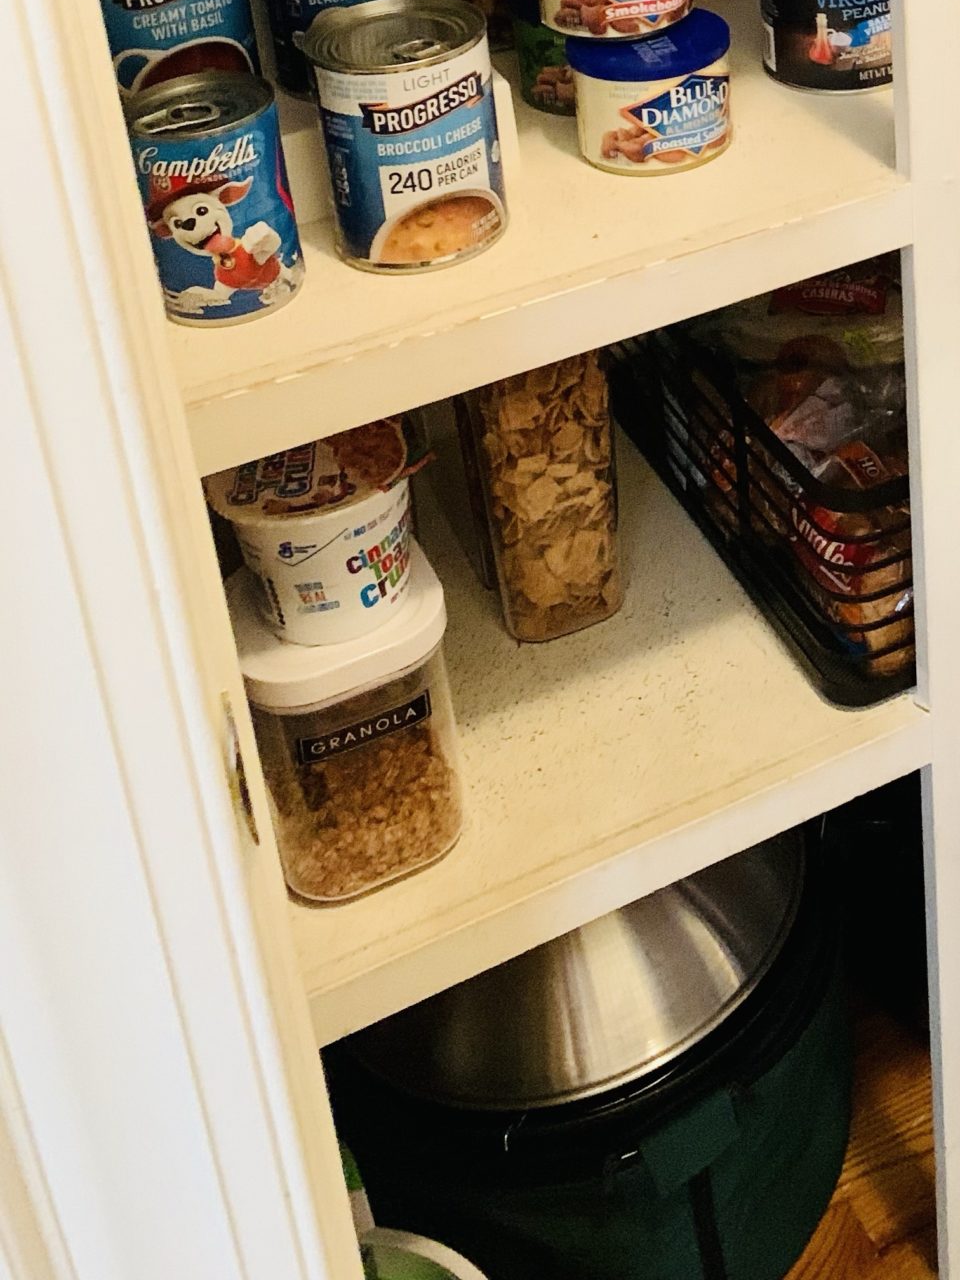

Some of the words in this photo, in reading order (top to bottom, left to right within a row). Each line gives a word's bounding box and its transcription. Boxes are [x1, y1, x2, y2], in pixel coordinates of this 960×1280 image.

[132, 5, 187, 30] CREAMY
[151, 21, 188, 41] WITH
[191, 10, 225, 32] BASIL
[842, 2, 891, 21] PEANU
[402, 68, 451, 92] LIGHT
[669, 78, 716, 108] BLUE
[373, 76, 478, 133] PROGRESSO
[641, 81, 728, 128] DIAMOND
[377, 136, 442, 157] BROCCOLI
[445, 116, 483, 145] CHEESE
[651, 132, 702, 153] Roasted
[435, 147, 483, 175] CALORIES
[437, 172, 457, 187] PER
[459, 163, 479, 181] CAN
[388, 168, 433, 195] 240
[310, 705, 418, 756] GRANOLA
